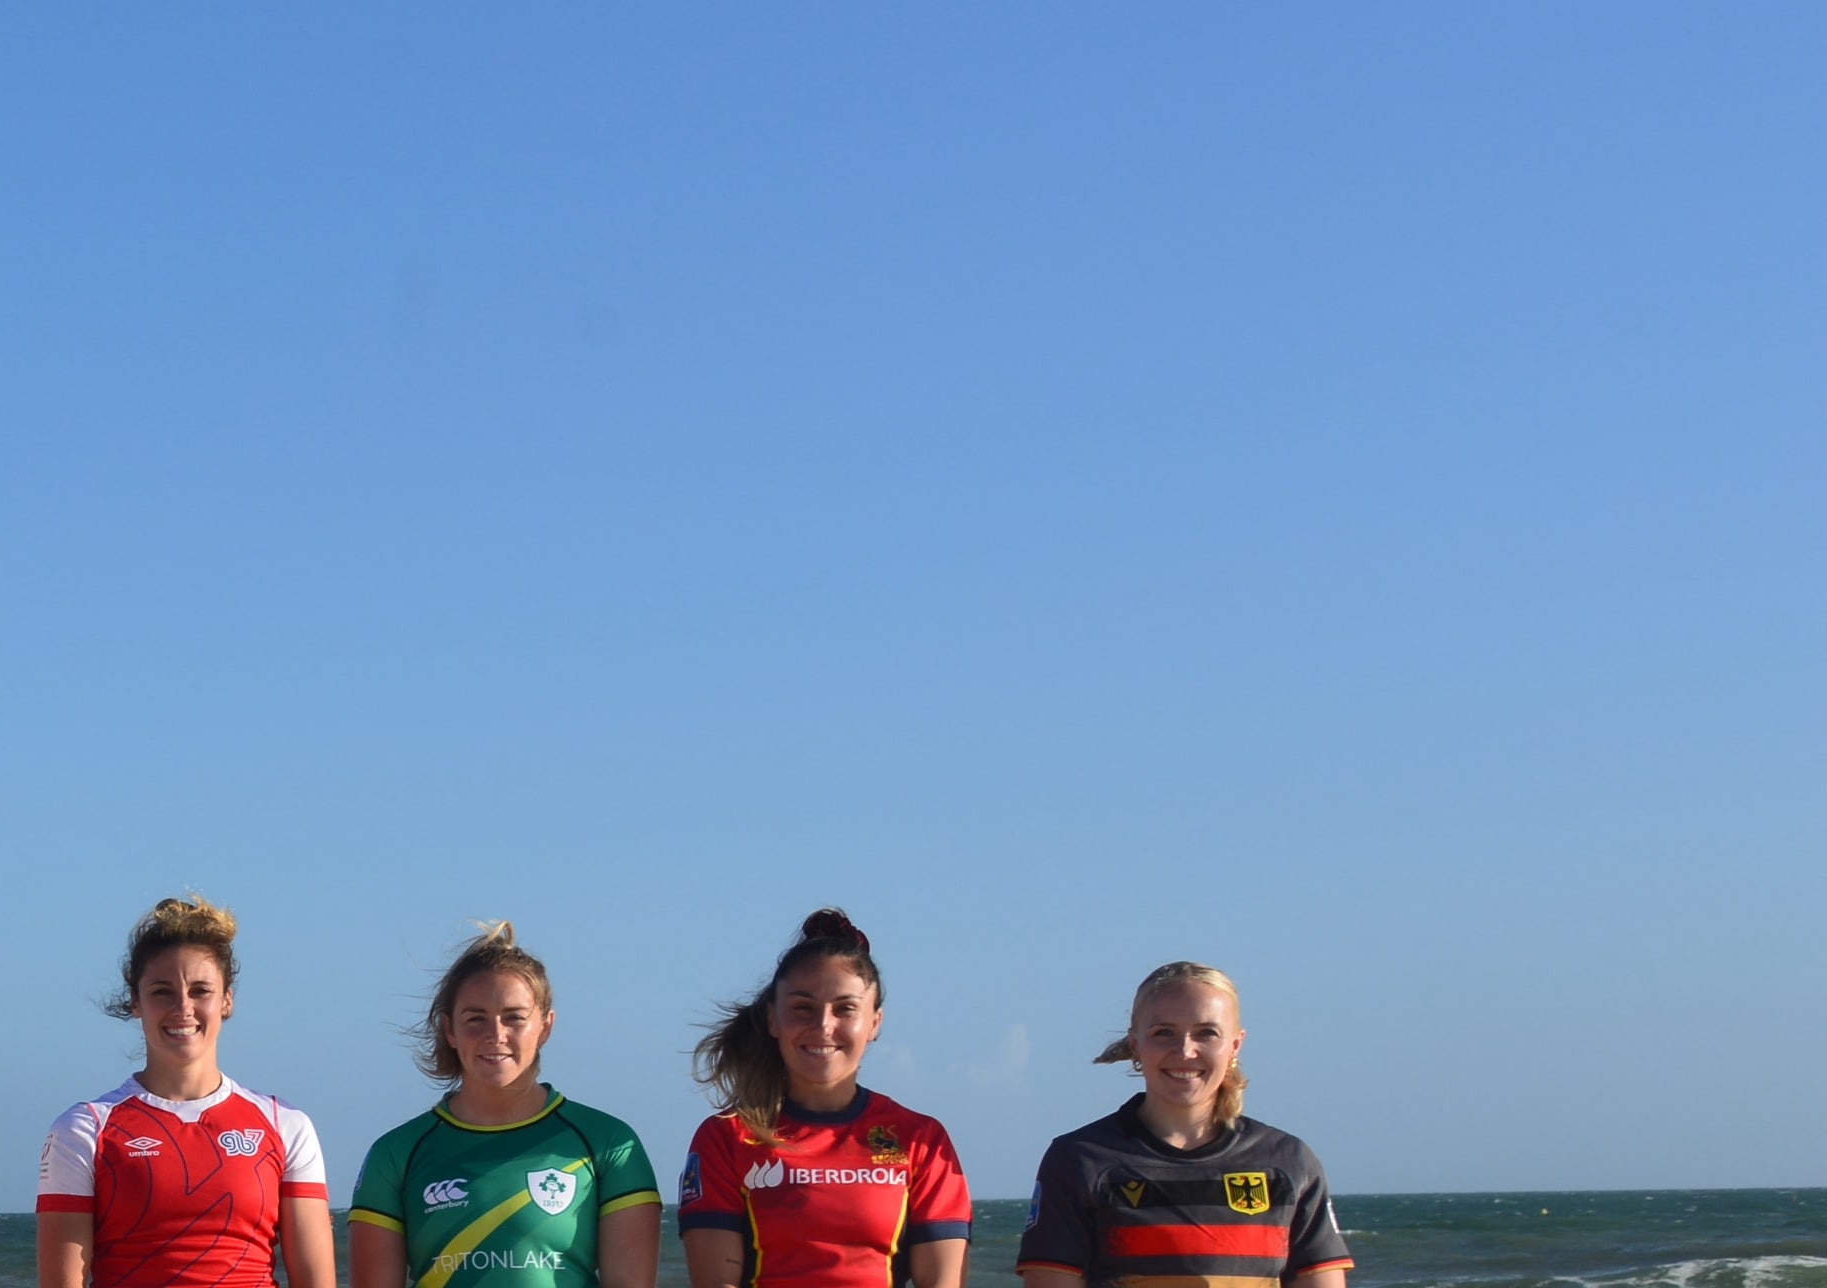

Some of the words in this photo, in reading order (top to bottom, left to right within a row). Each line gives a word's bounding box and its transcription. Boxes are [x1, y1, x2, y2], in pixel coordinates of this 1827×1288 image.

[789, 1167, 907, 1186] IBERDROLA
[424, 1200, 470, 1214] canterbury
[431, 1250, 566, 1274] TRITONLAKE
